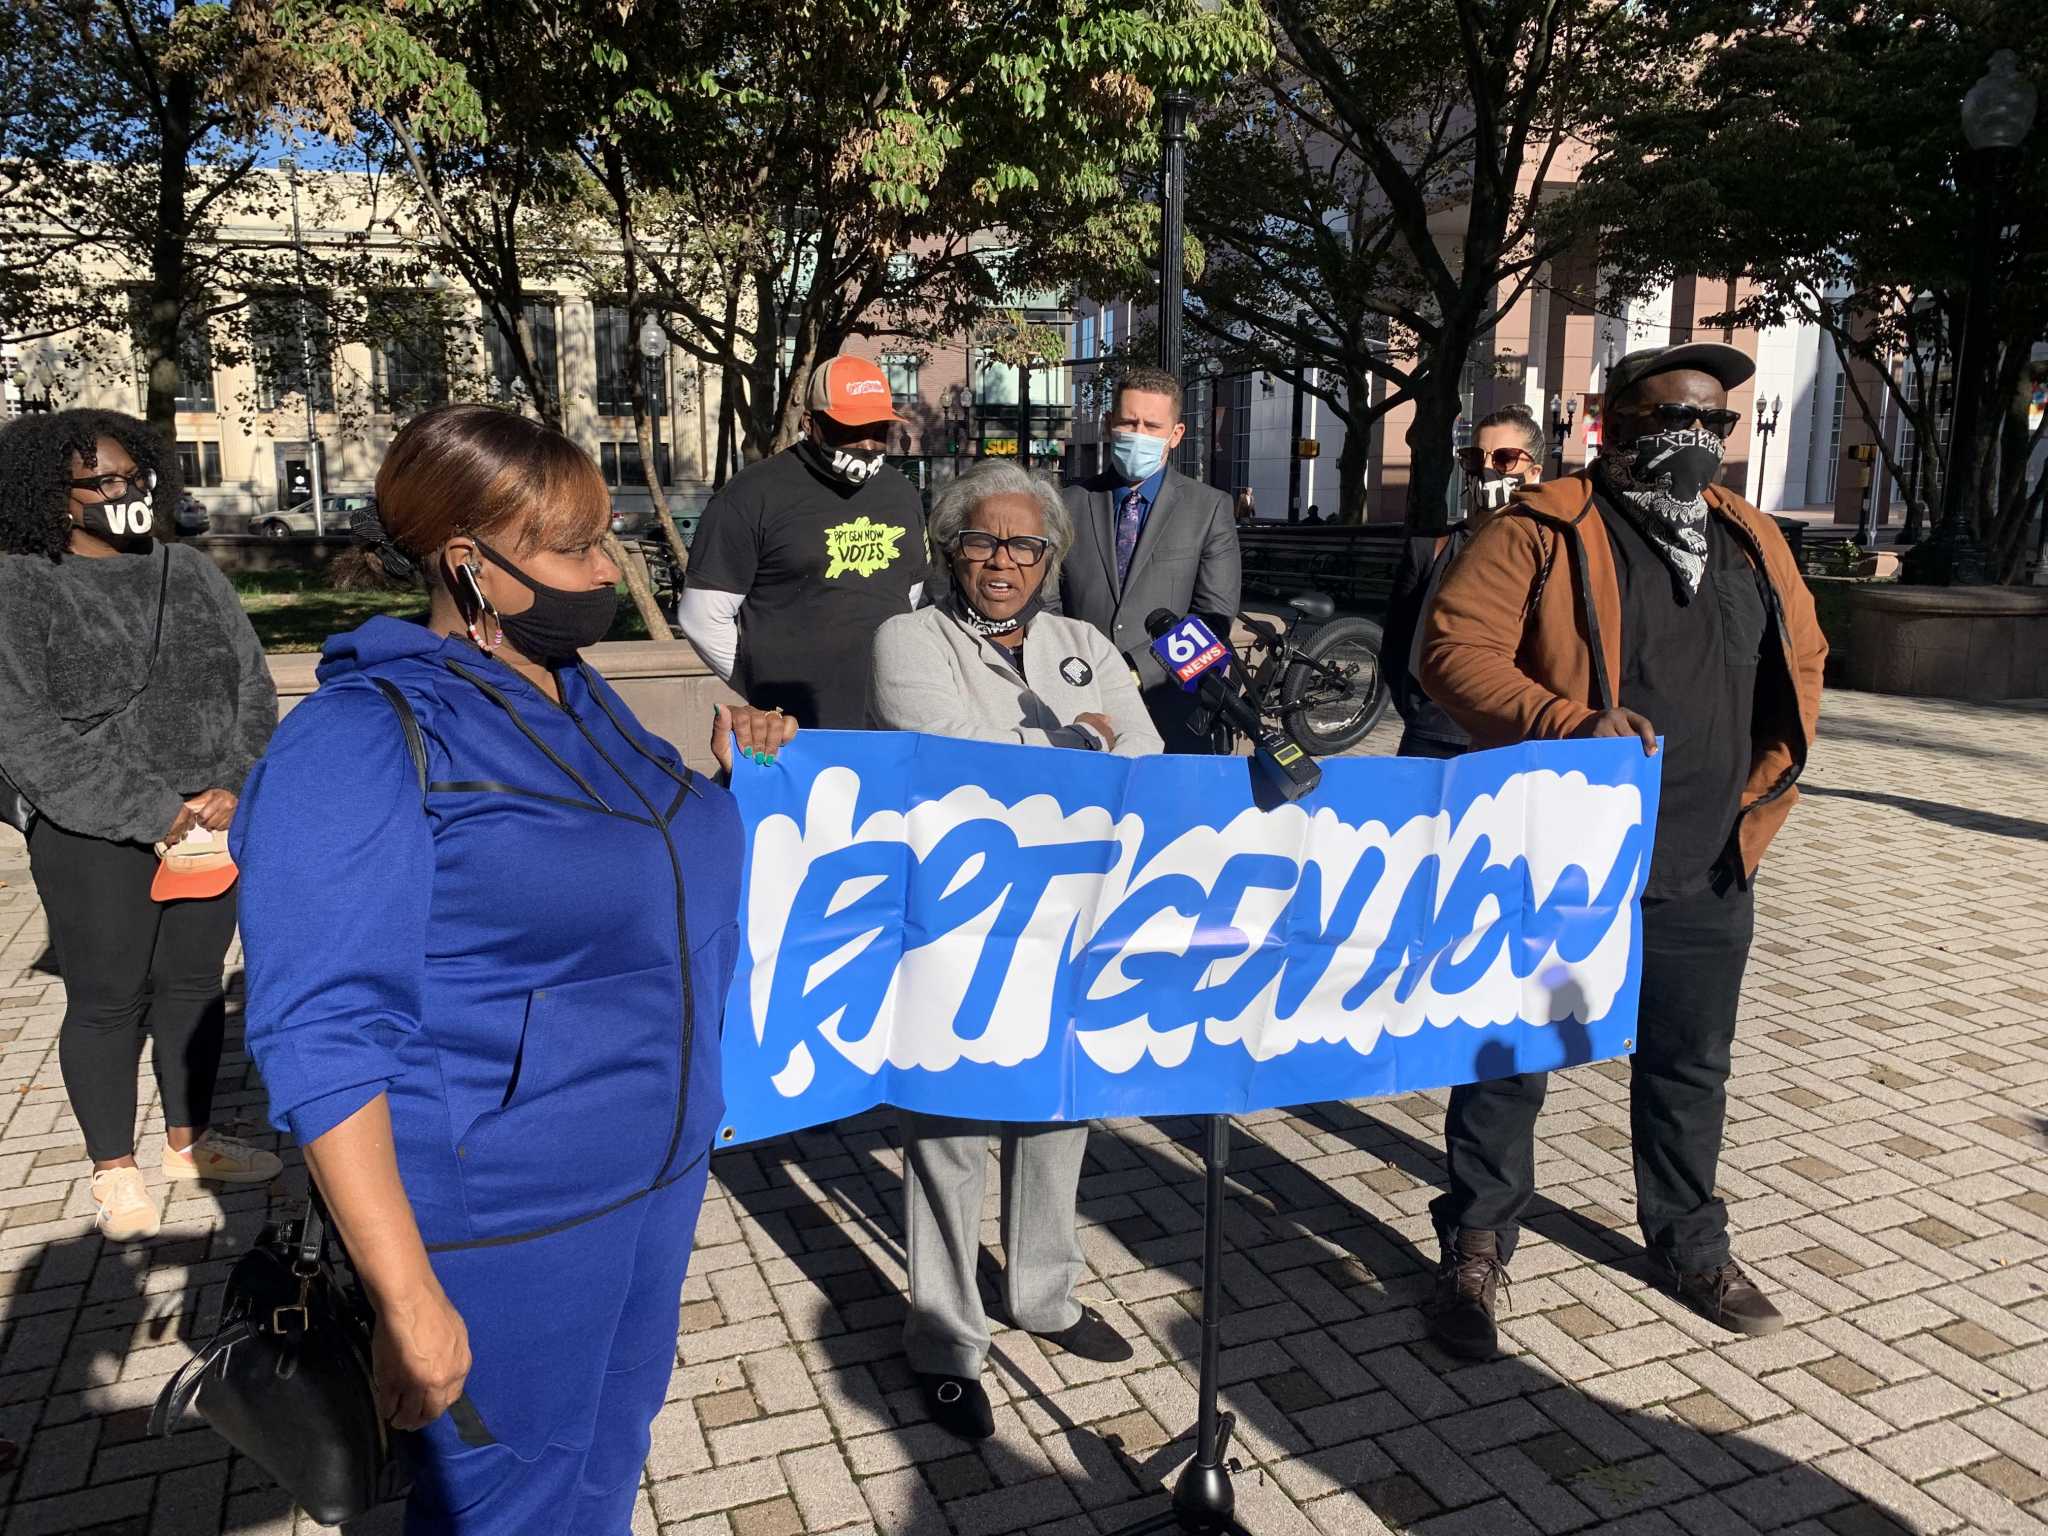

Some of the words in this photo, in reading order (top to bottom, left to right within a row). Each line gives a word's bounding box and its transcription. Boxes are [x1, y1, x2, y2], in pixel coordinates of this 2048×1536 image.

[834, 530, 848, 545] BPT
[849, 530, 863, 542] GEN
[865, 530, 884, 541] NOW
[838, 543, 885, 563] VOTES
[1167, 622, 1210, 662] 61
[1181, 644, 1222, 678] NEWS
[1072, 846, 1386, 1034] GEN
[1342, 824, 1643, 1010] NOW
